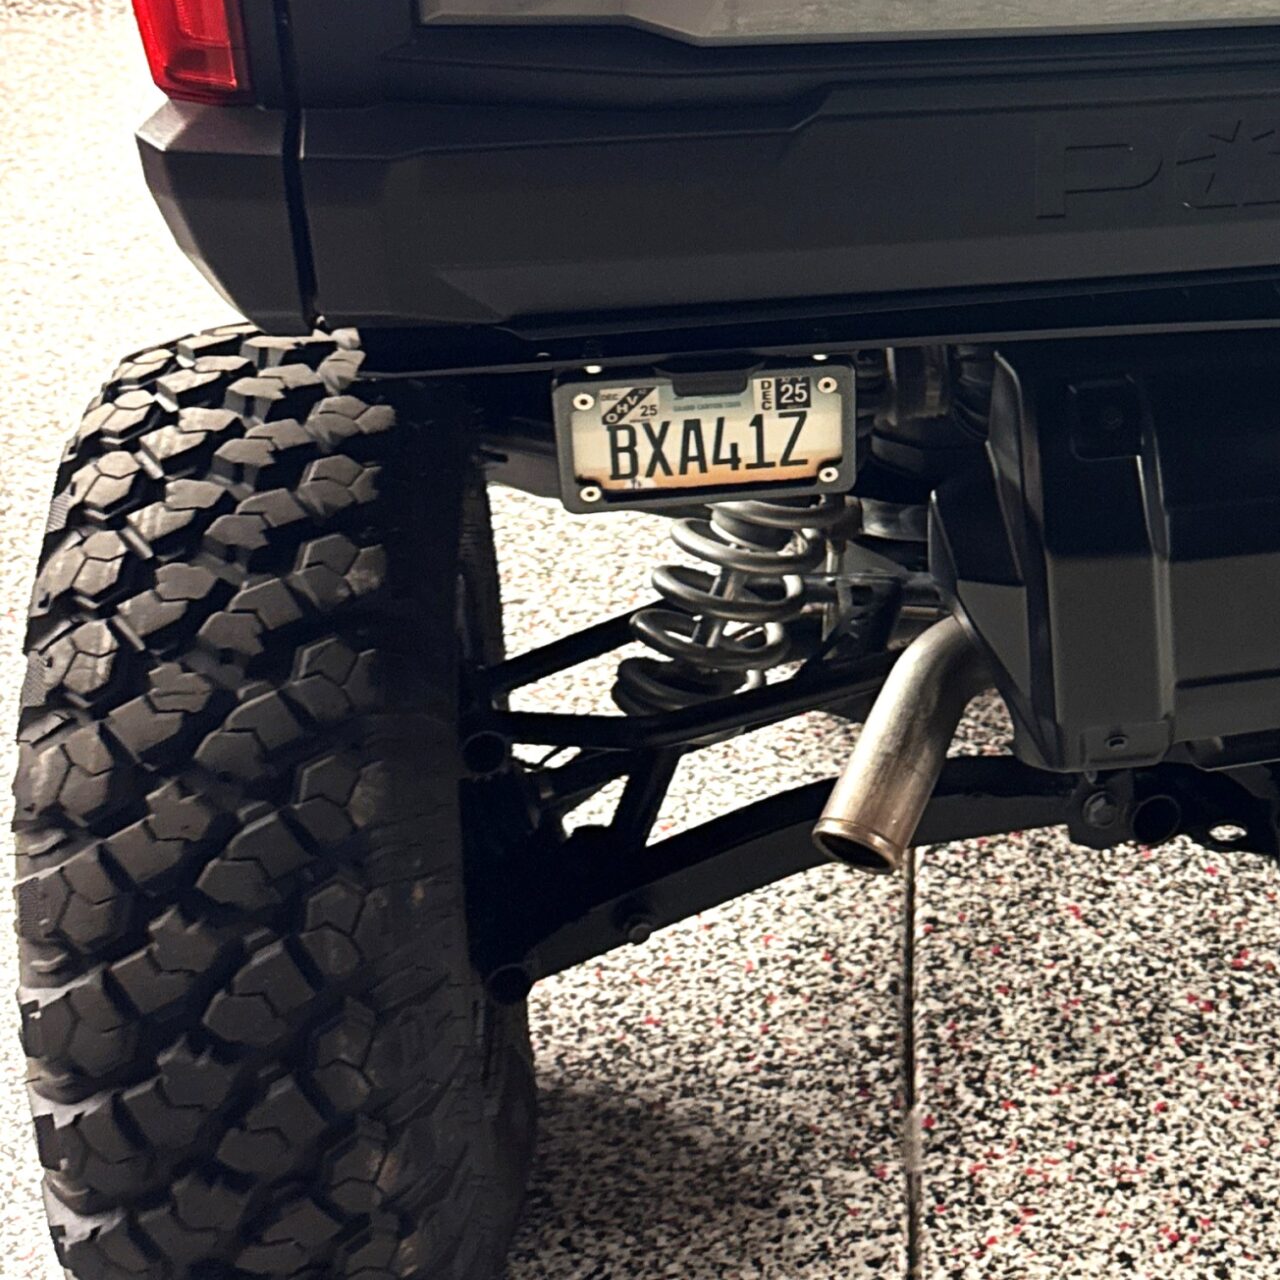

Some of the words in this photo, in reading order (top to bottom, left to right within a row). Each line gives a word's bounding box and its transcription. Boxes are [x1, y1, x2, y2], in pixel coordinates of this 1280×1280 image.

[760, 380, 772, 410] DEC
[780, 383, 808, 403] 25
[640, 404, 658, 417] 25
[606, 410, 809, 481] BXA41Z
